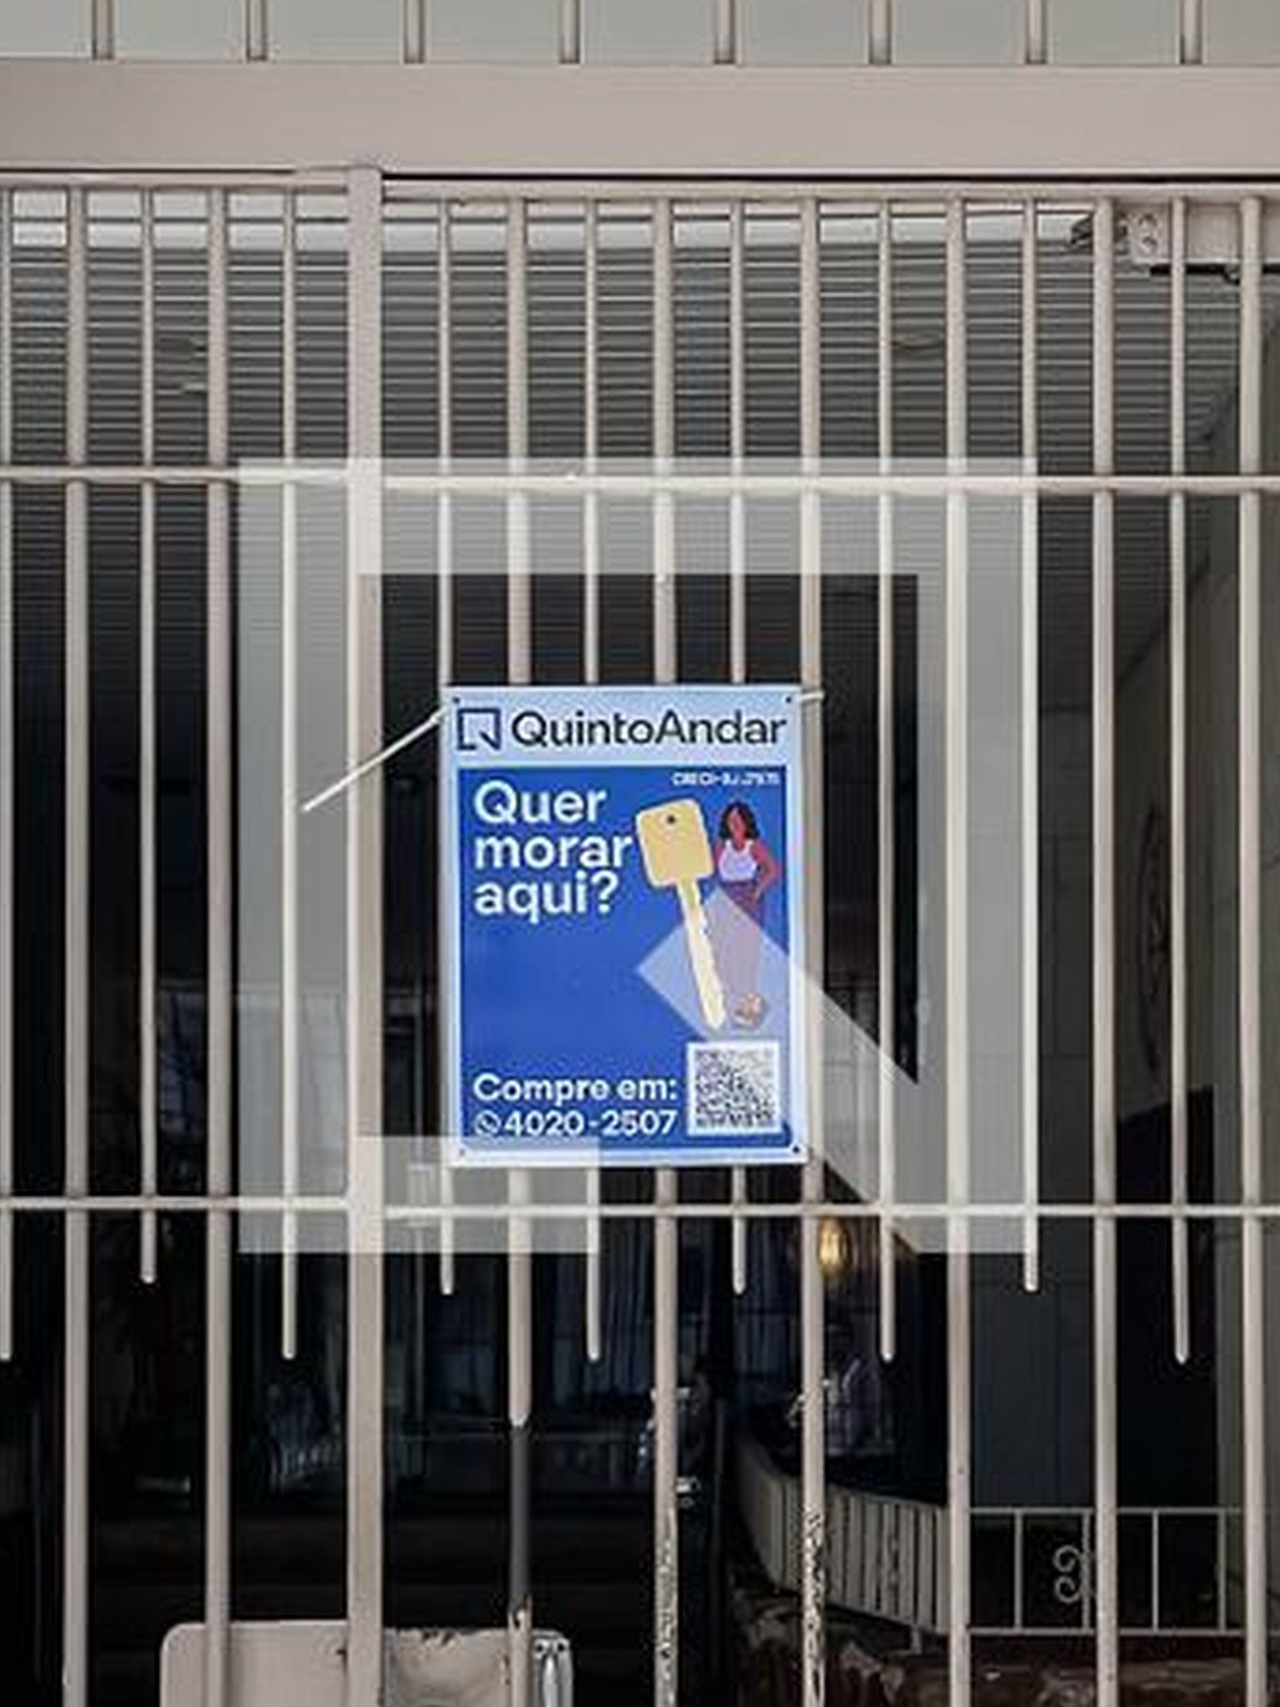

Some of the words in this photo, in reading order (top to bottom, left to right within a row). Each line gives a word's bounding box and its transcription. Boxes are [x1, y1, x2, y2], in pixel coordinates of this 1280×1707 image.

[512, 709, 787, 747] QuintoAndar
[474, 781, 607, 824] Quer
[474, 835, 633, 869] morar
[474, 873, 619, 924] aqui?
[473, 1073, 610, 1106] Compre
[619, 1079, 678, 1101] em:
